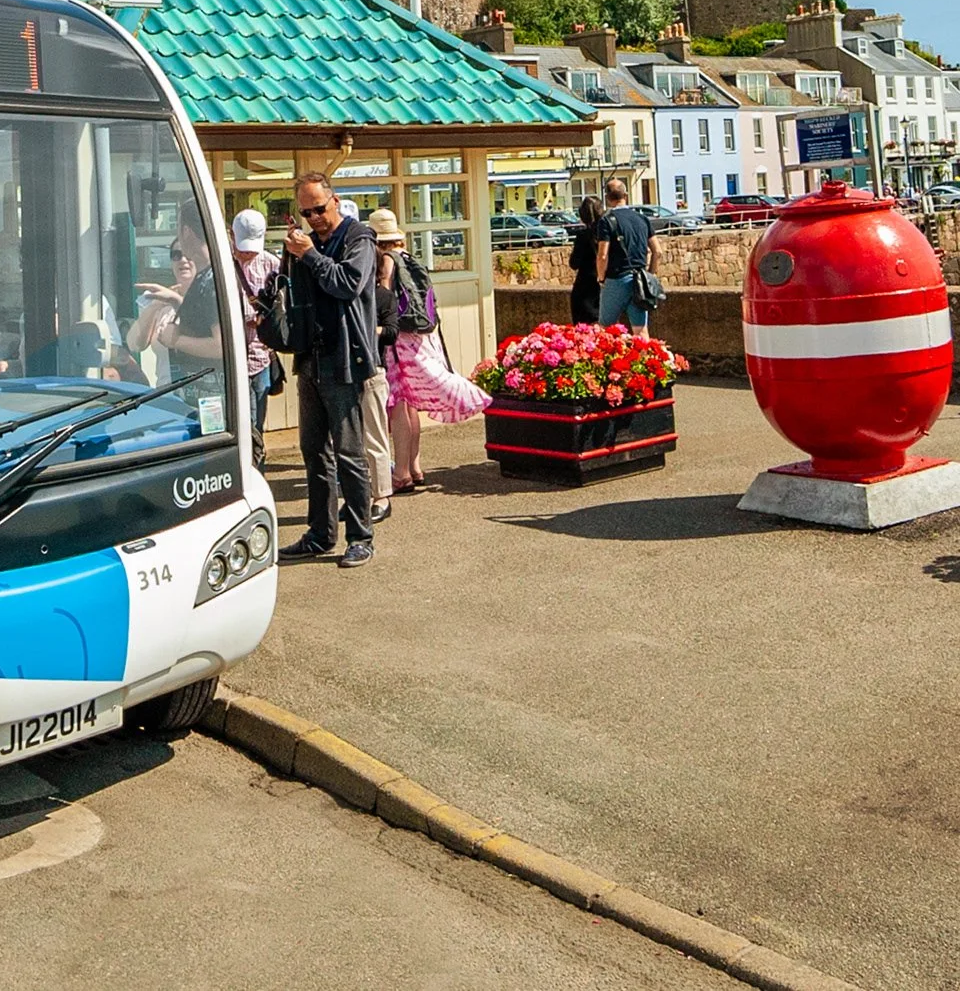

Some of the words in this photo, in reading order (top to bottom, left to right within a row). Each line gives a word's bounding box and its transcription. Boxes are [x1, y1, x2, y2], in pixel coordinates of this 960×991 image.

[20, 20, 39, 93] 1
[183, 473, 232, 502] Optare
[137, 564, 173, 591] 314
[0, 699, 98, 756] J122014
